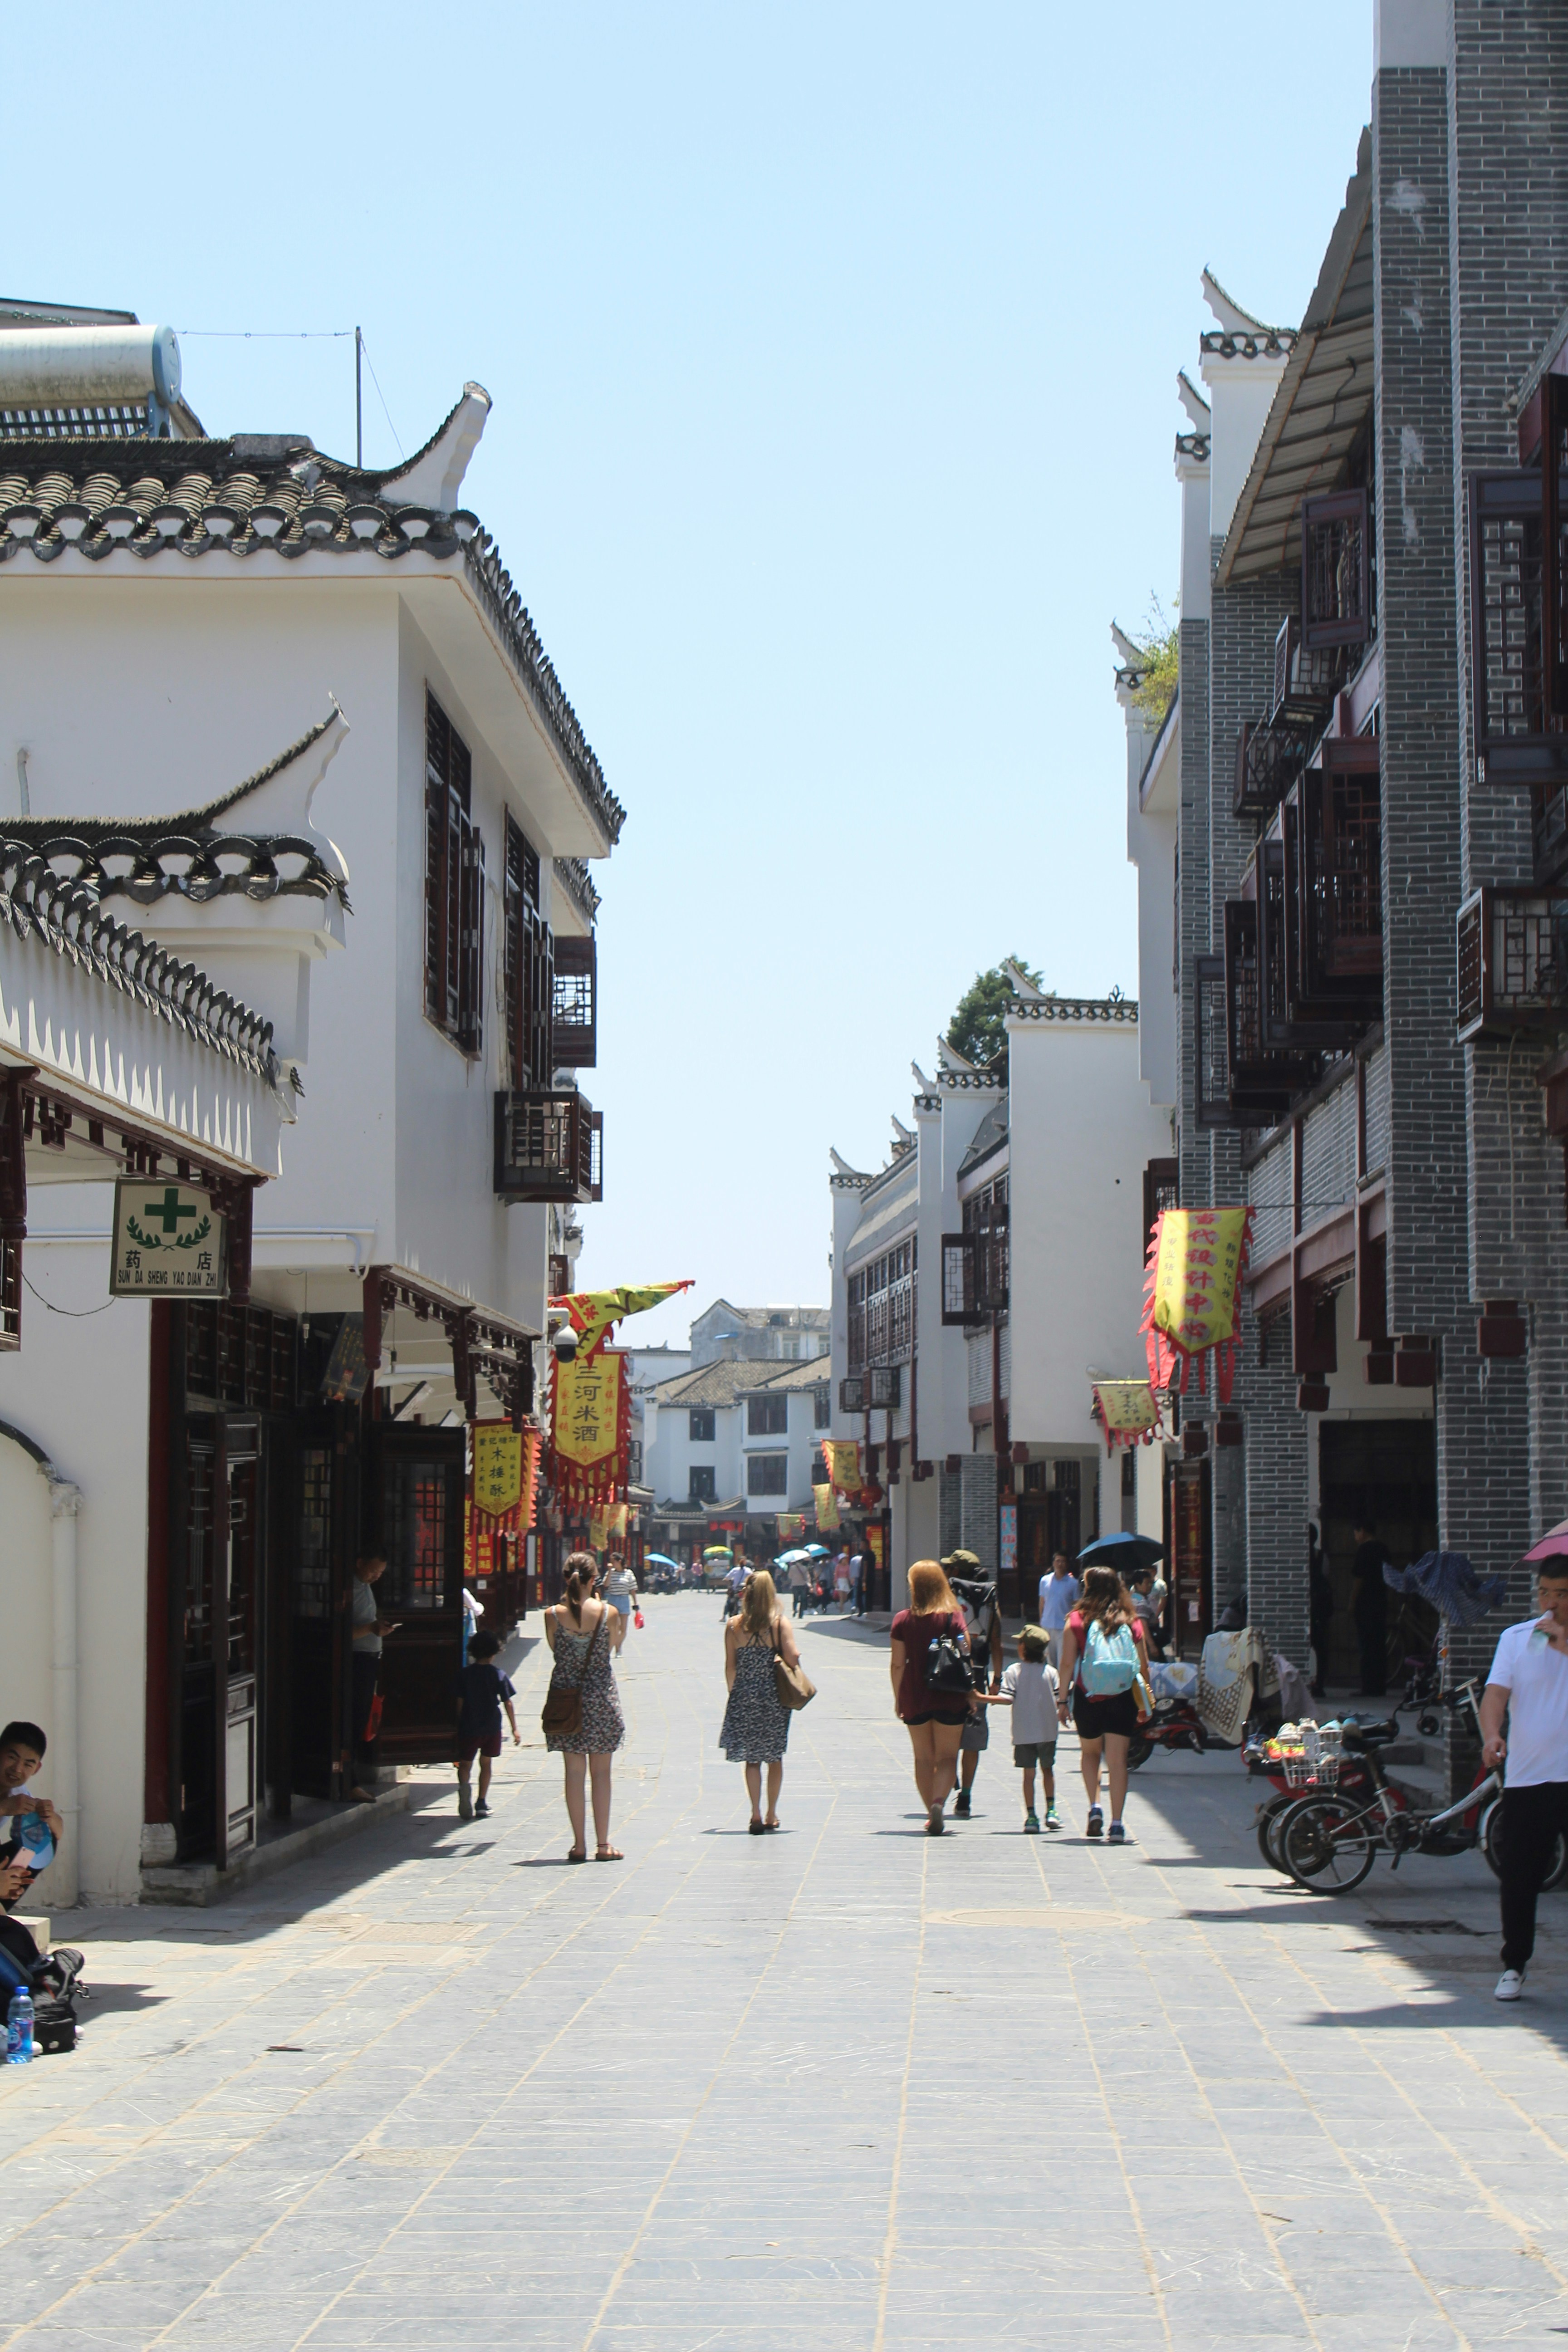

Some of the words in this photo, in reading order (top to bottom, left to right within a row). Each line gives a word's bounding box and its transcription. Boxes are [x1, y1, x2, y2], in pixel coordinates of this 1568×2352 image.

[118, 1269, 131, 1284] SUN
[135, 1270, 143, 1284] DA
[147, 1270, 168, 1285] SHENG
[172, 1271, 185, 1285] YAO
[187, 1272, 202, 1286] DIAN
[206, 1273, 216, 1287] ZHI
[126, 1250, 212, 1270] 药店
[558, 1374, 571, 1432] 厂家直销
[572, 1365, 603, 1442] 三河米酒
[603, 1374, 616, 1432] 古镇特色
[489, 1447, 507, 1497] 木捶酥
